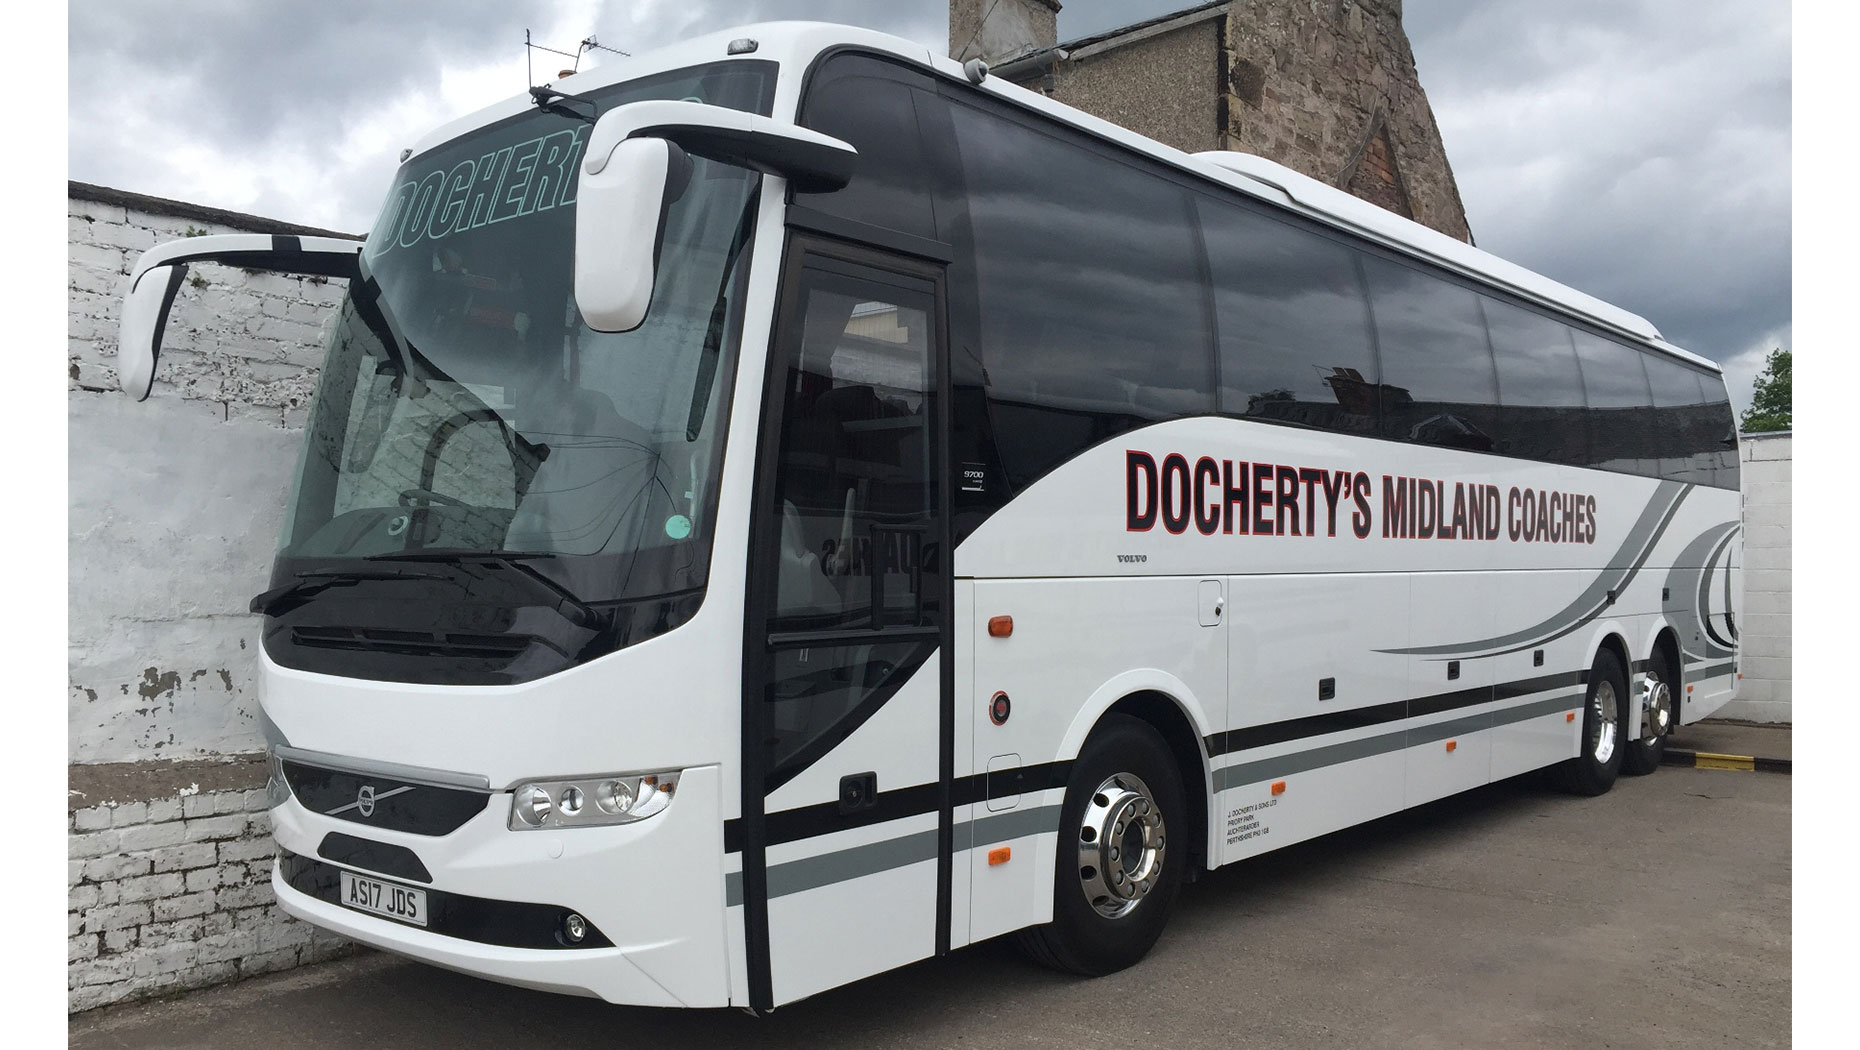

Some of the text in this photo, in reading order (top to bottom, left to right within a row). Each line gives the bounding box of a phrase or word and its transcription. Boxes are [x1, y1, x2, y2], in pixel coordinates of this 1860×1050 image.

[370, 123, 593, 258] DOCHERT
[963, 470, 984, 479] 9700
[1126, 449, 1596, 544] DOCHERTY'S MIDLAND COACHES
[1117, 554, 1148, 563] VOLVO
[1232, 804, 1255, 817] DOCHERTY
[1258, 801, 1270, 810] SONS
[1227, 814, 1255, 827] PRIORY PARK
[1227, 832, 1252, 845] PERTHSHIRE
[350, 877, 417, 918] AS17 JDS
